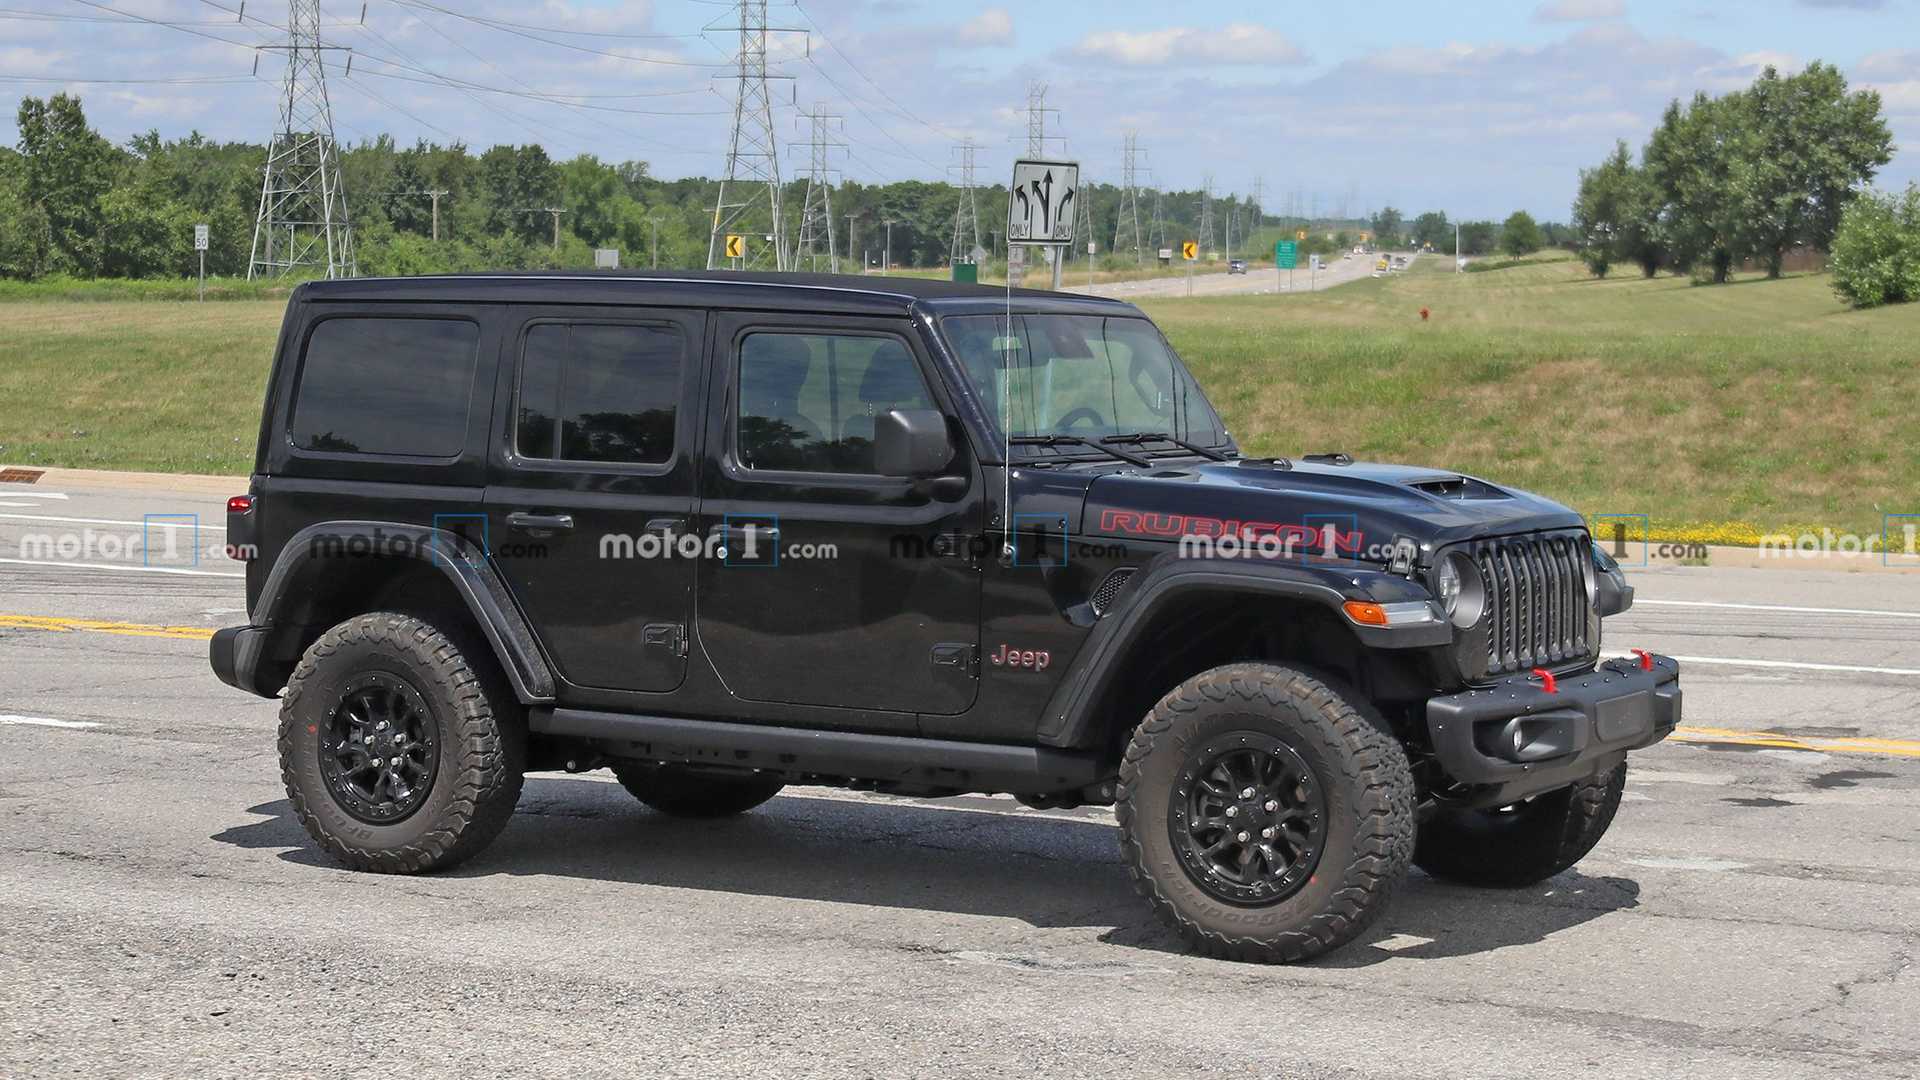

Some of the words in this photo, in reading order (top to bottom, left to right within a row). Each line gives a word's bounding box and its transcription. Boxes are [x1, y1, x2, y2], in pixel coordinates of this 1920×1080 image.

[1010, 224, 1029, 237] ONLY
[1055, 225, 1072, 238] ONLY
[196, 238, 207, 248] 50
[1100, 509, 1363, 553] RUBICON
[991, 644, 1050, 672] Jeep
